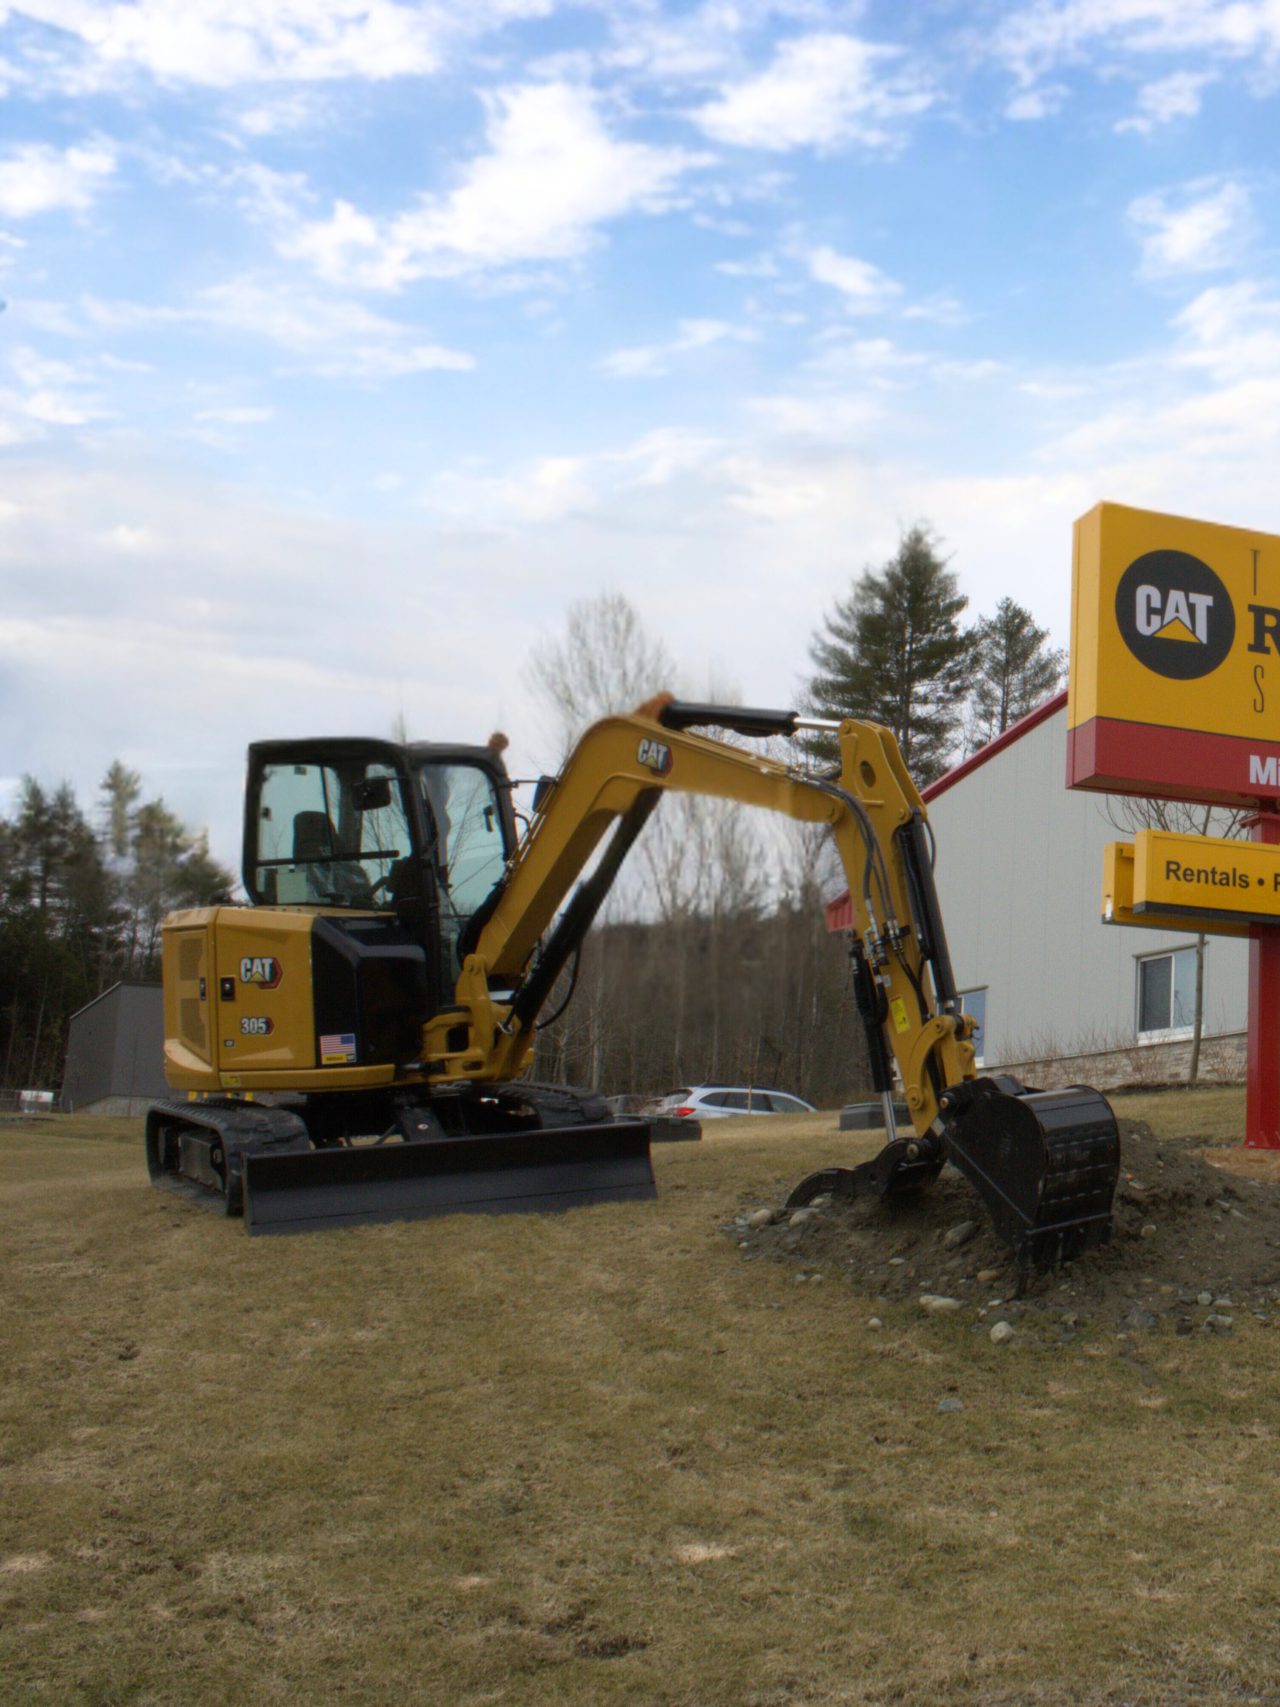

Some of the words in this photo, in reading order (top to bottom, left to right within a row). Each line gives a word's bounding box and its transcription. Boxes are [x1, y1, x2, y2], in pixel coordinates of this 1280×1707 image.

[1135, 584, 1213, 645] CAT
[638, 738, 668, 770] CAT
[1165, 860, 1250, 889] Rentals
[240, 957, 273, 983] CAT
[240, 1017, 267, 1034] 305
